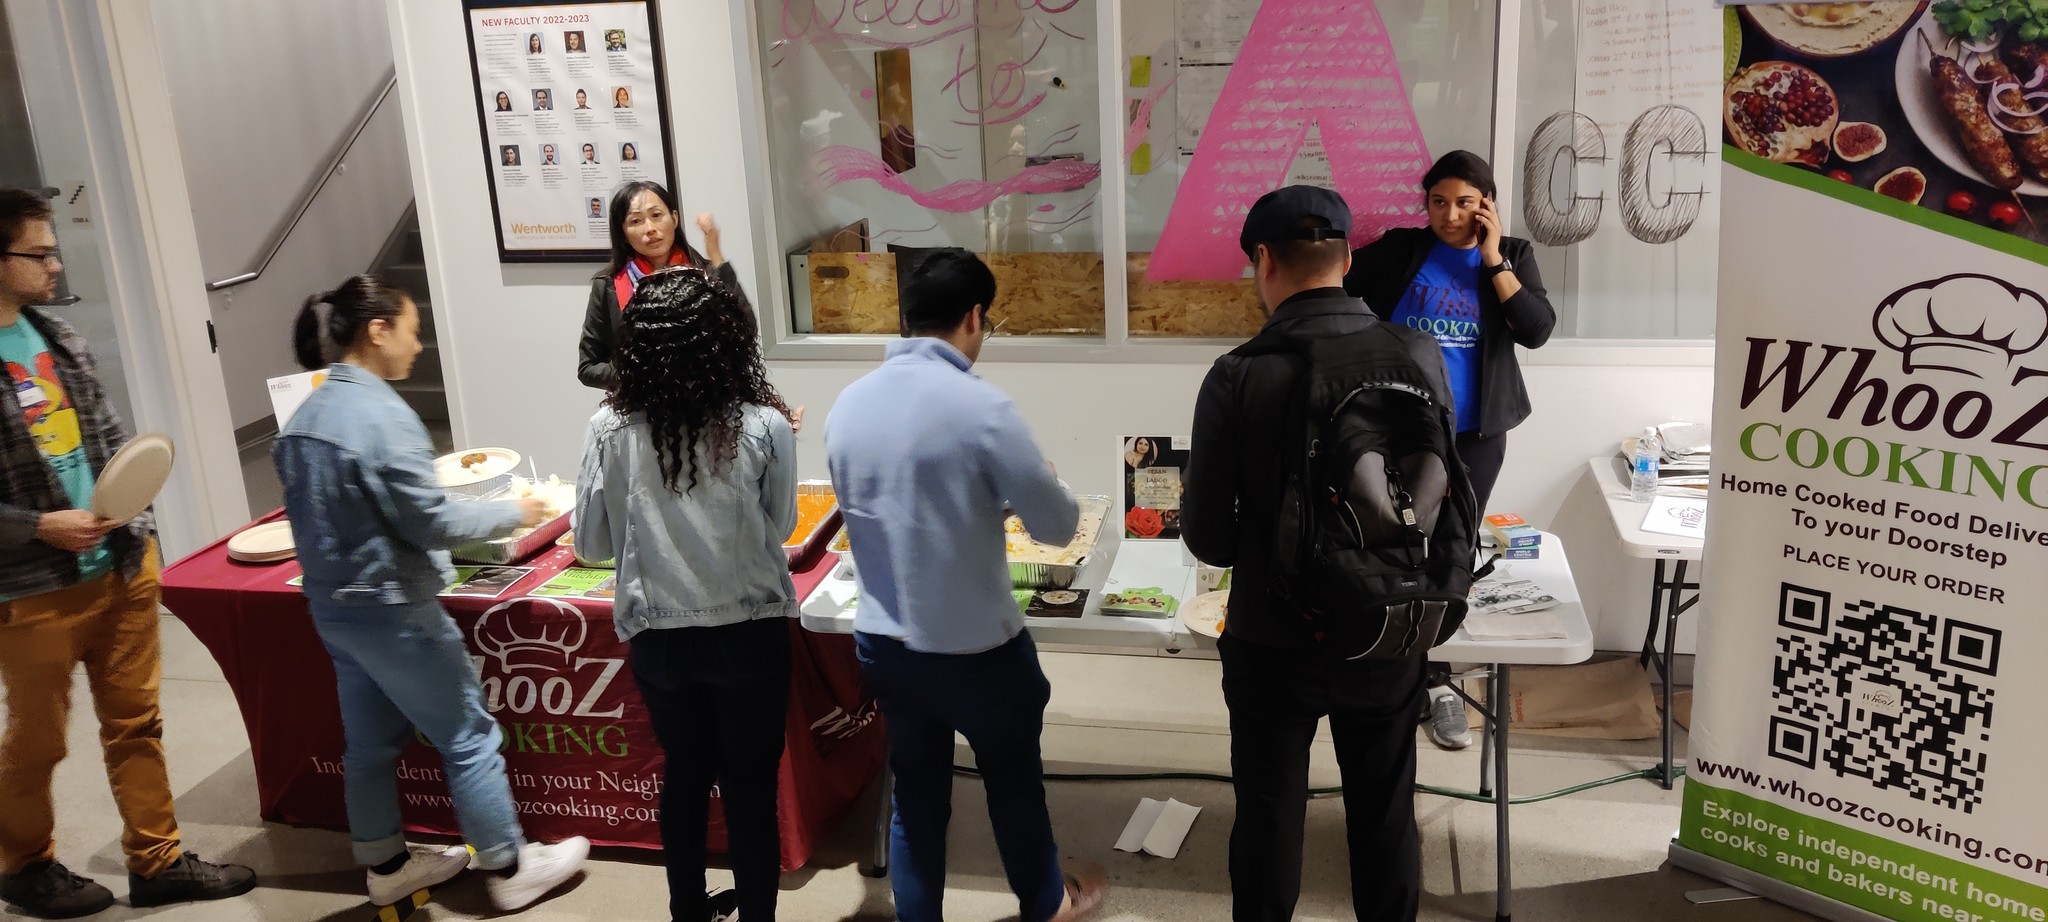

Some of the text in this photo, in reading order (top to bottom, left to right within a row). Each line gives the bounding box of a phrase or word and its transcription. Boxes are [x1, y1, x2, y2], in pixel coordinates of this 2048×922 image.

[481, 14, 590, 27] NEW FACULTY 2022-2023
[510, 222, 577, 235] Wentworth
[1720, 473, 1788, 498] Home
[1794, 484, 1886, 516] Cooked
[1895, 502, 1960, 530] Food
[1791, 508, 2008, 569] To your Doorstep
[1783, 544, 2006, 604] PLACE YOUR ORDER
[470, 655, 626, 719] hooZ
[311, 756, 443, 782] Inddent
[514, 768, 536, 788] in
[541, 776, 592, 797] your
[1700, 826, 1984, 922] cooks and bakers near
[1702, 800, 2046, 922] Explore independent home
